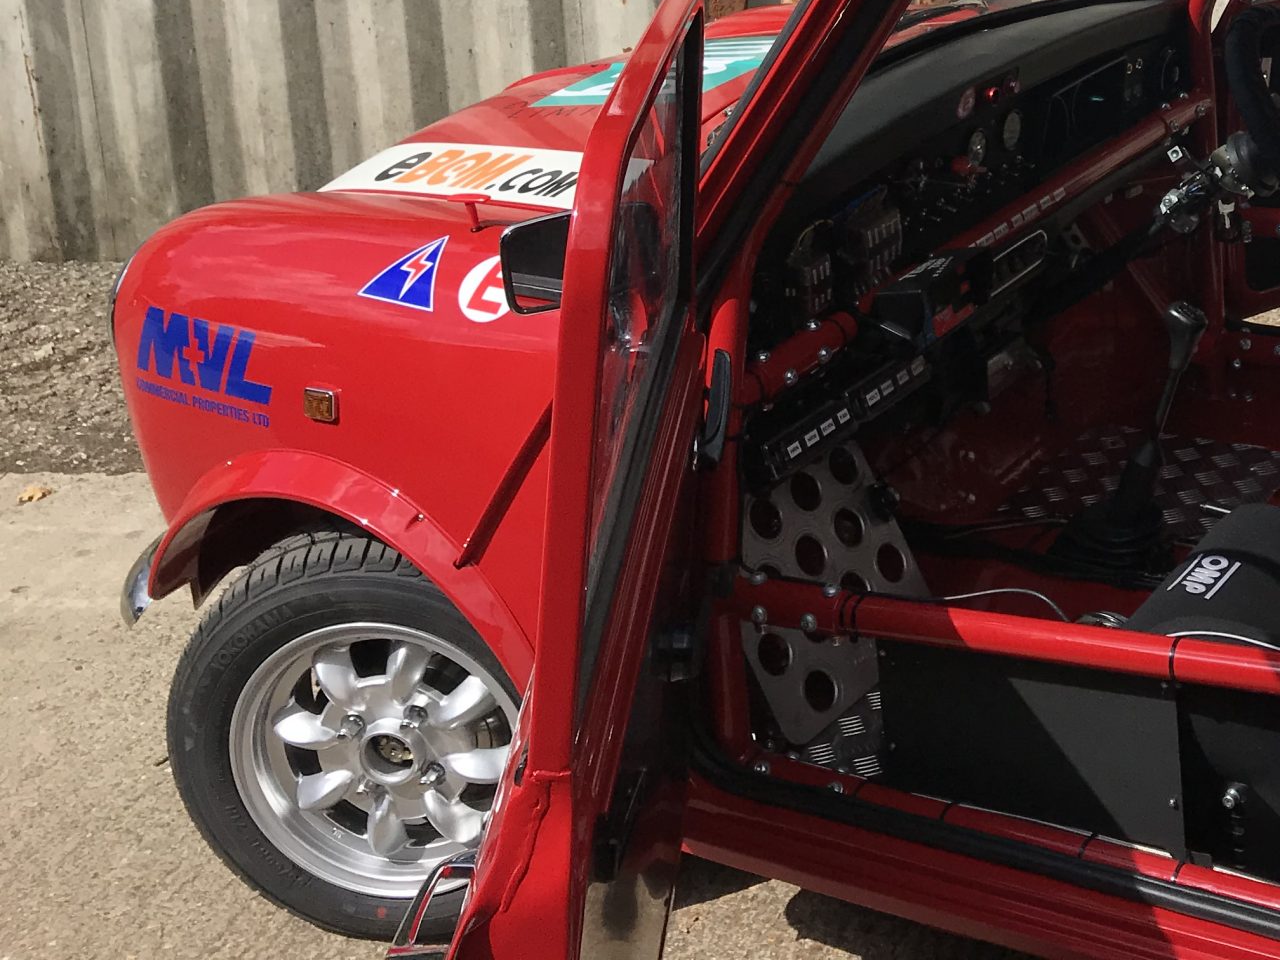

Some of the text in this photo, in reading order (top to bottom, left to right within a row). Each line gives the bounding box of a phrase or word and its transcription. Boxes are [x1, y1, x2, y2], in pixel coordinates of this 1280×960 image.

[136, 377, 271, 429] COMMERCIAL PROPERTIES LTD
[1185, 554, 1230, 595] OMP
